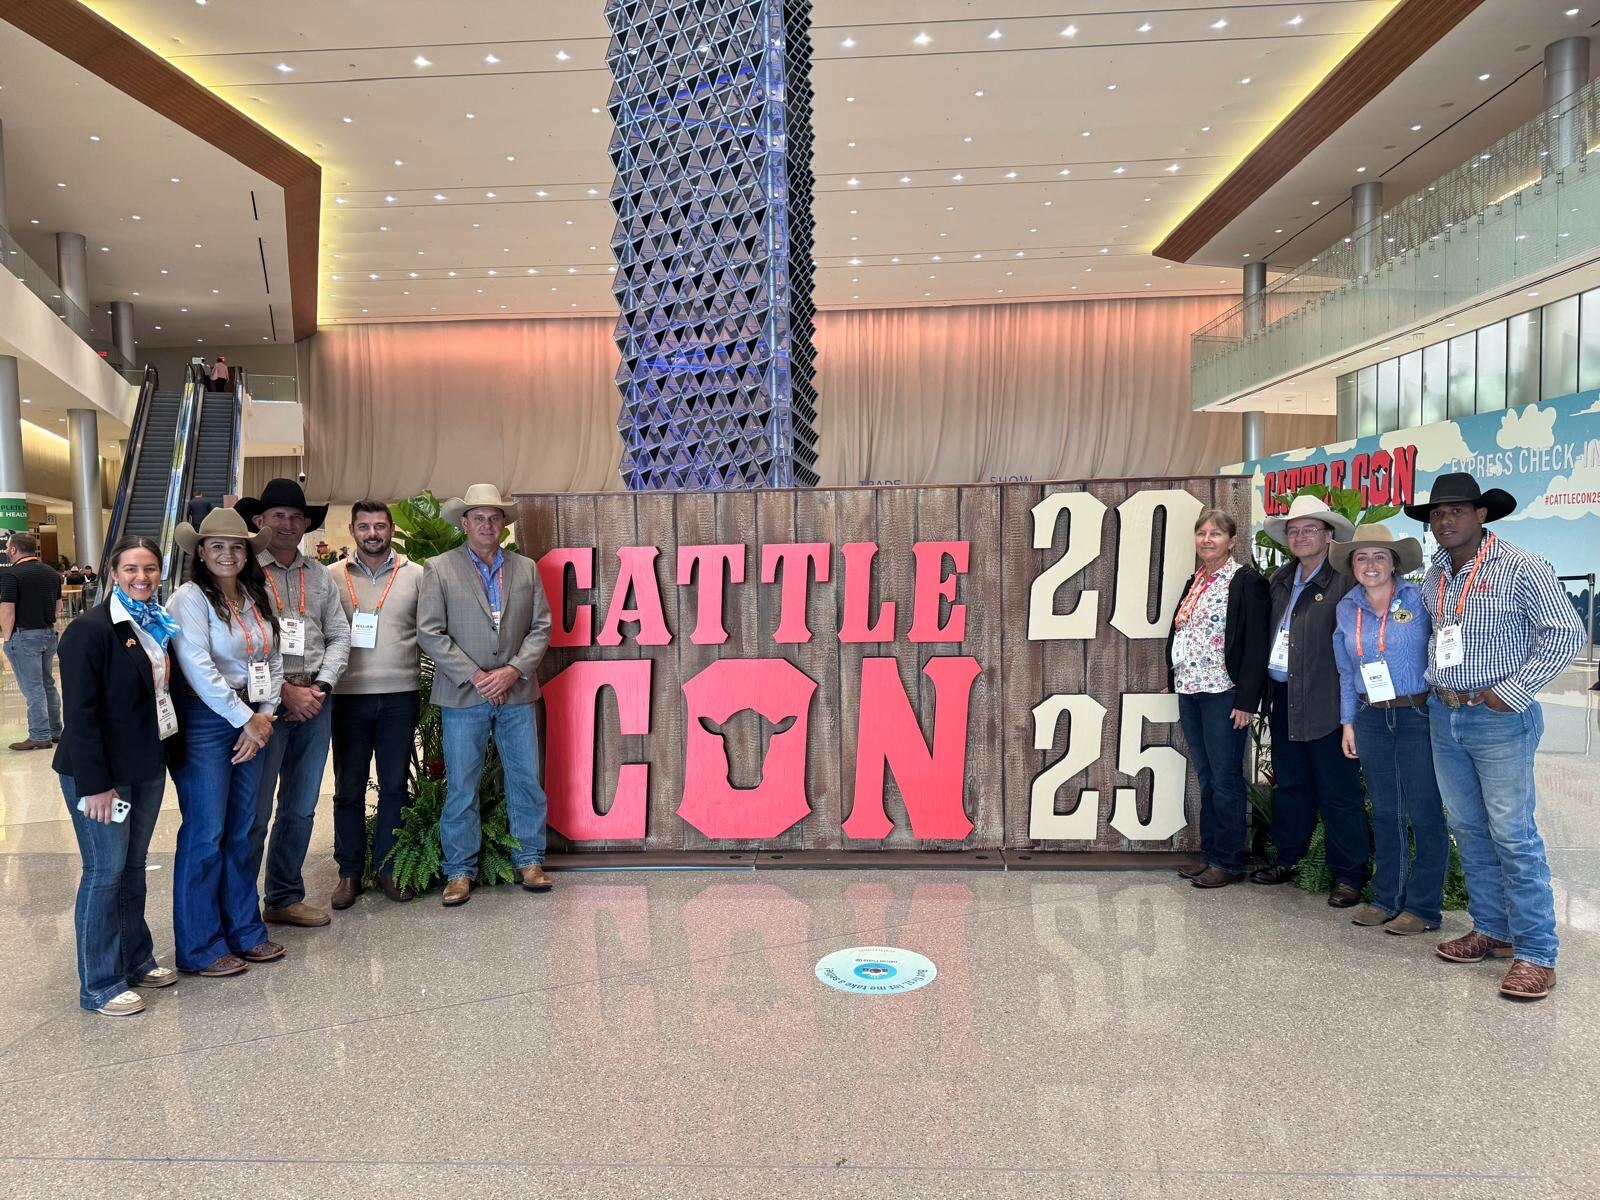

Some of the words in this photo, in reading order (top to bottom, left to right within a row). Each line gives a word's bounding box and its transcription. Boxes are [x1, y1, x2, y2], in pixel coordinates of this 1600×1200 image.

[1351, 444, 1419, 512] CON
[1451, 451, 1513, 478] EXPRESS
[538, 540, 970, 647] CATTLE
[1027, 489, 1205, 641] 20
[540, 655, 984, 841] CON
[1028, 691, 1189, 841] 25
[845, 982, 867, 991] take
